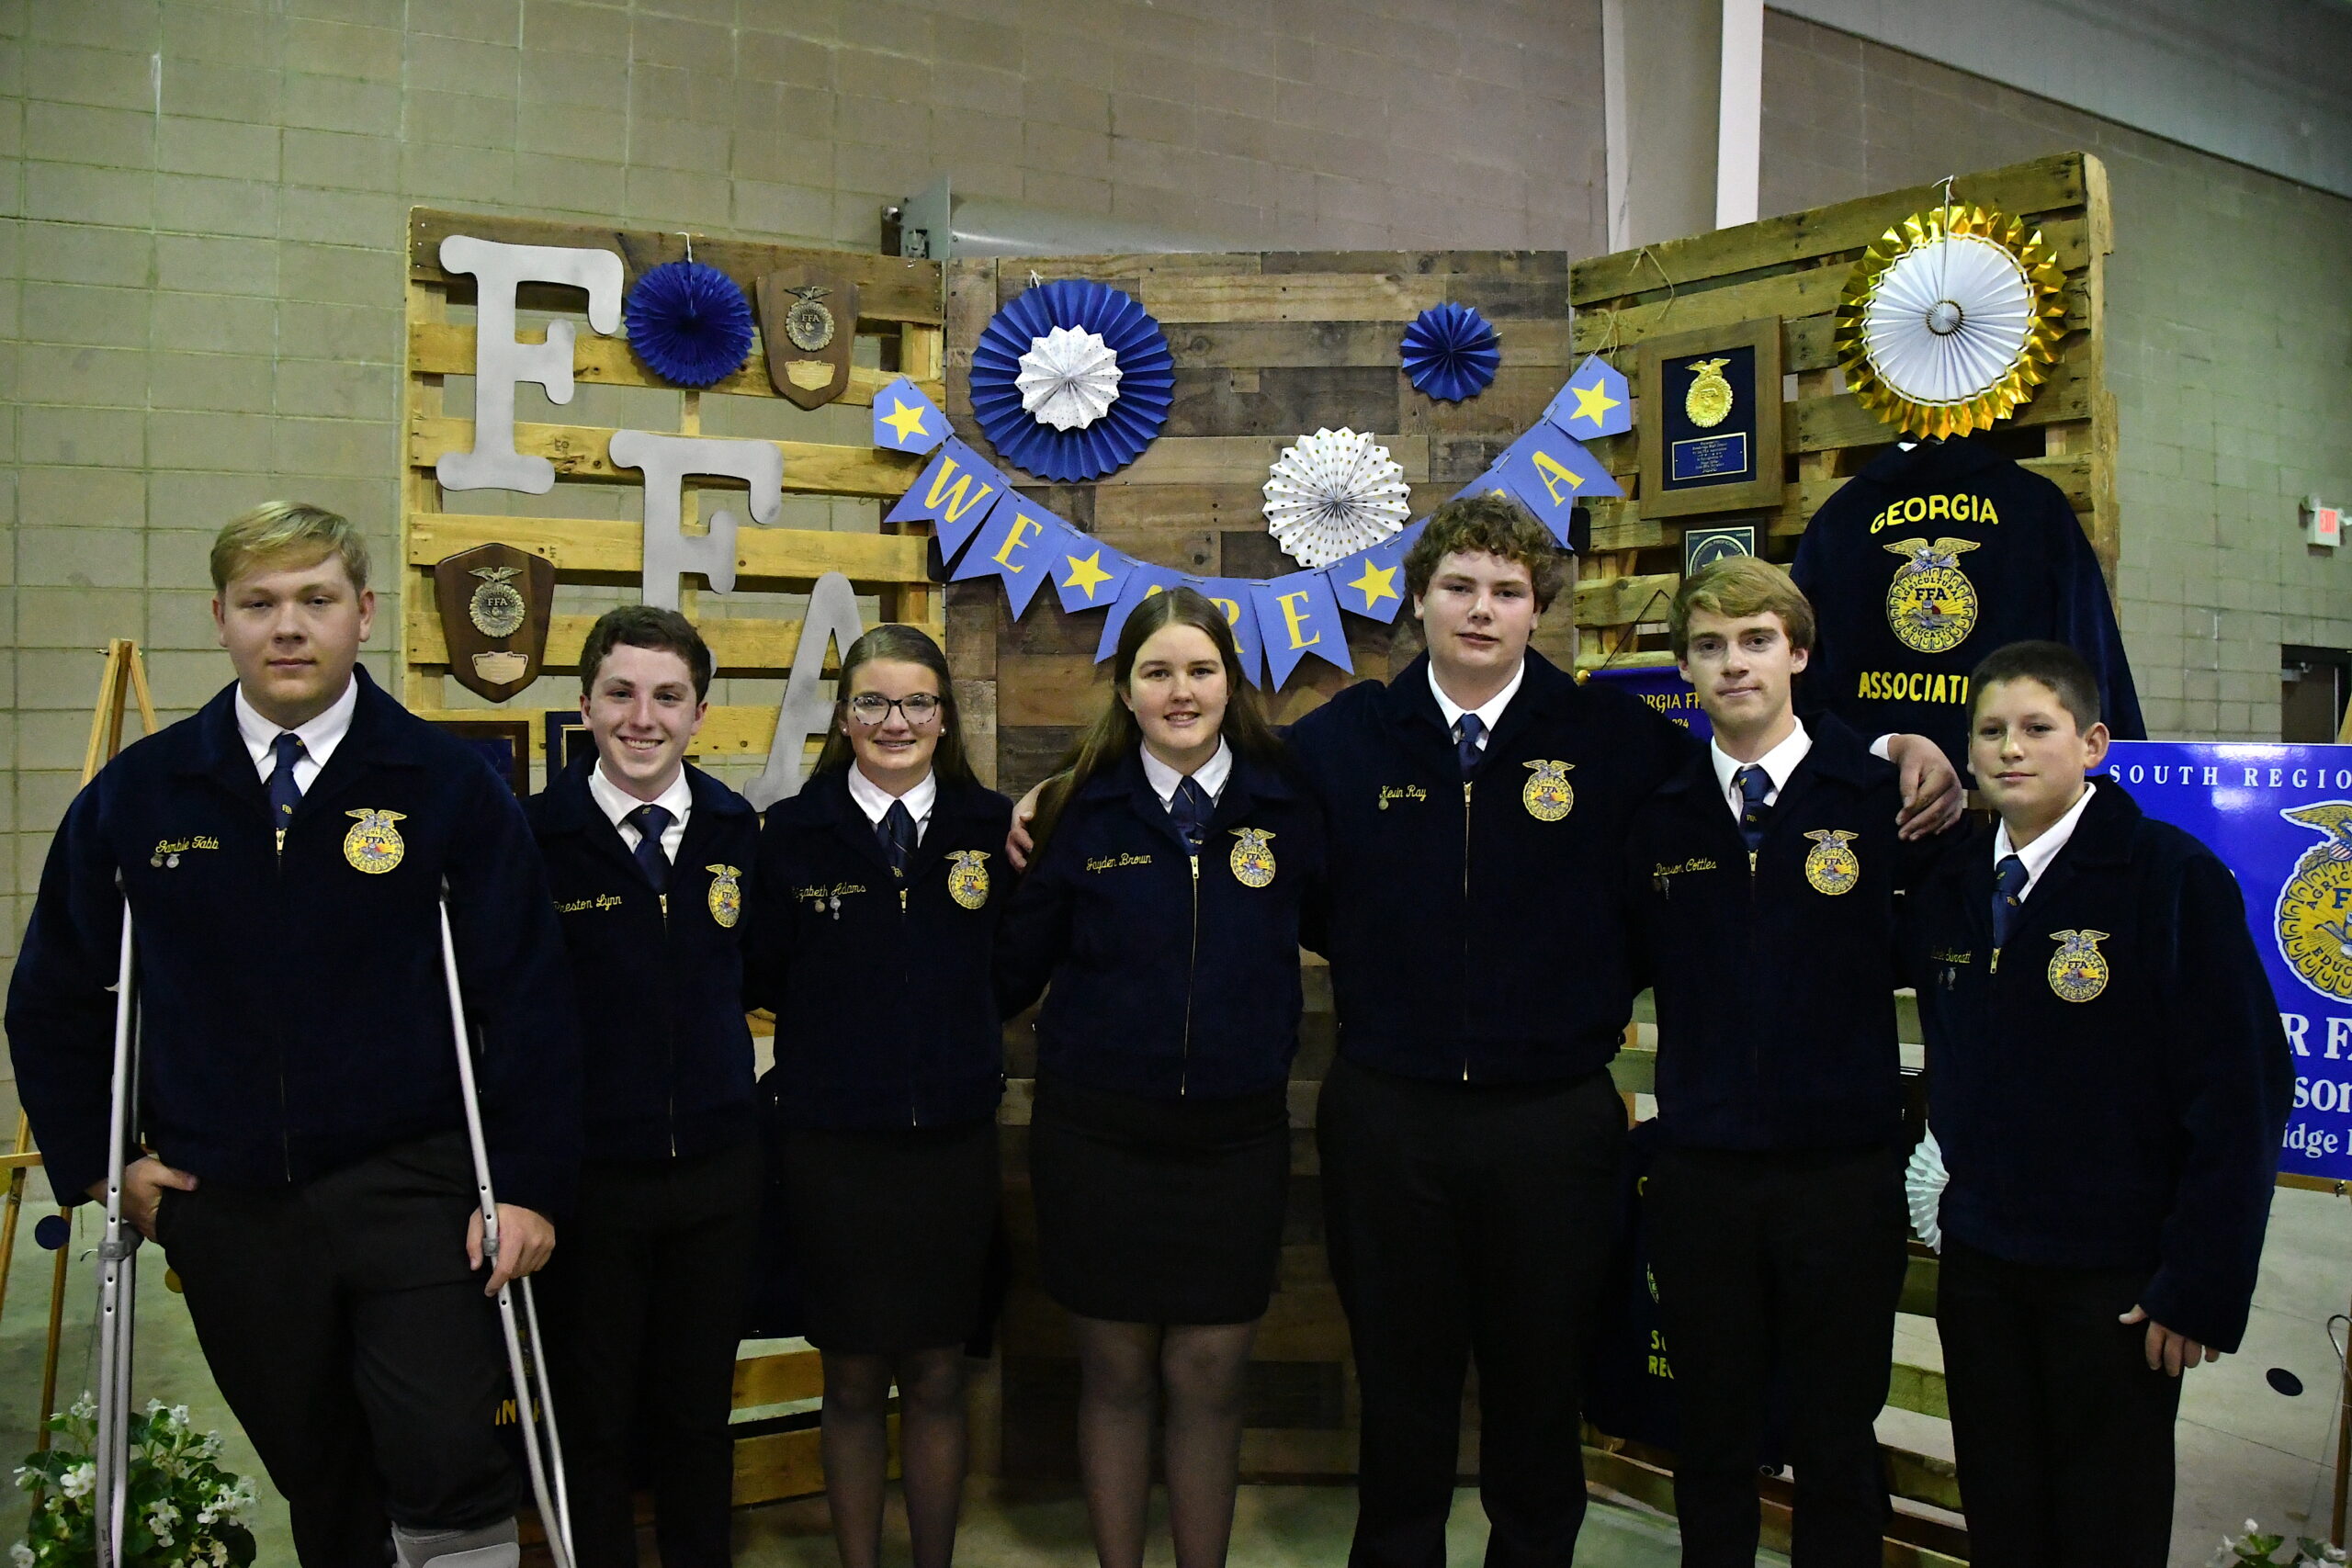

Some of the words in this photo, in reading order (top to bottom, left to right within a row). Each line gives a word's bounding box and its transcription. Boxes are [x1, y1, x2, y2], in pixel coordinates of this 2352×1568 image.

[802, 313, 820, 322] FFA
[924, 456, 1043, 573] WE
[1870, 493, 1999, 535] GEORGIA
[2320, 509, 2338, 534] EXIT
[1901, 577, 1961, 603] AGRICULTURAL
[1915, 587, 1948, 601] FFA
[488, 598, 508, 606] FFA
[1905, 622, 1957, 639] EDUCATION
[1685, 692, 1703, 710] FF
[2109, 764, 2218, 786] SOUTH
[191, 835, 220, 851] Tabb
[365, 836, 385, 844] FFA
[1118, 852, 1152, 867] Brown
[831, 882, 867, 897] Adams
[595, 893, 623, 912] Lynn
[2067, 961, 2087, 969] FFA
[2324, 1017, 2352, 1061] F
[1648, 1355, 1675, 1381] RE
